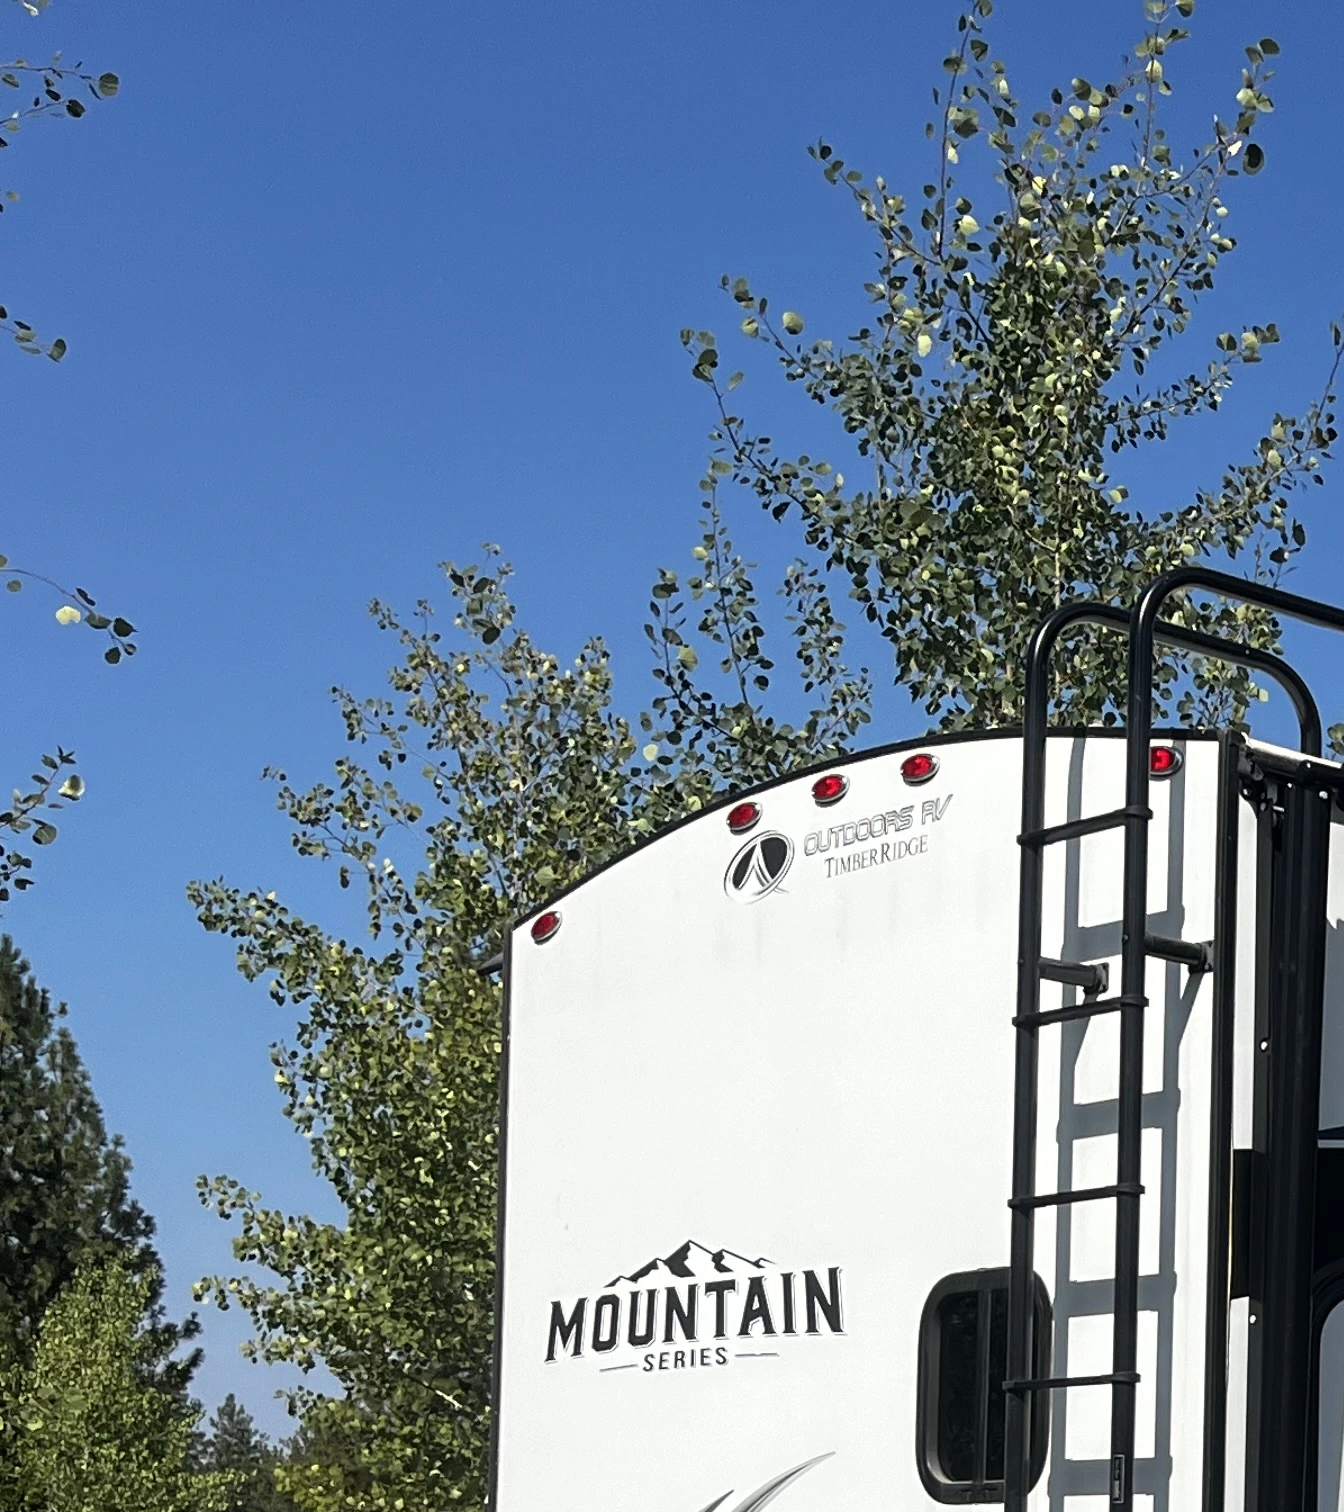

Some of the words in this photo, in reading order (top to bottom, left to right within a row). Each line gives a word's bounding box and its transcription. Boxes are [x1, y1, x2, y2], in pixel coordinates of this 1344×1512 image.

[803, 805, 915, 857] OUTDOORS
[921, 793, 954, 826] RV
[544, 1266, 848, 1364] MOUNTAIN
[642, 1347, 729, 1372] SERIES
